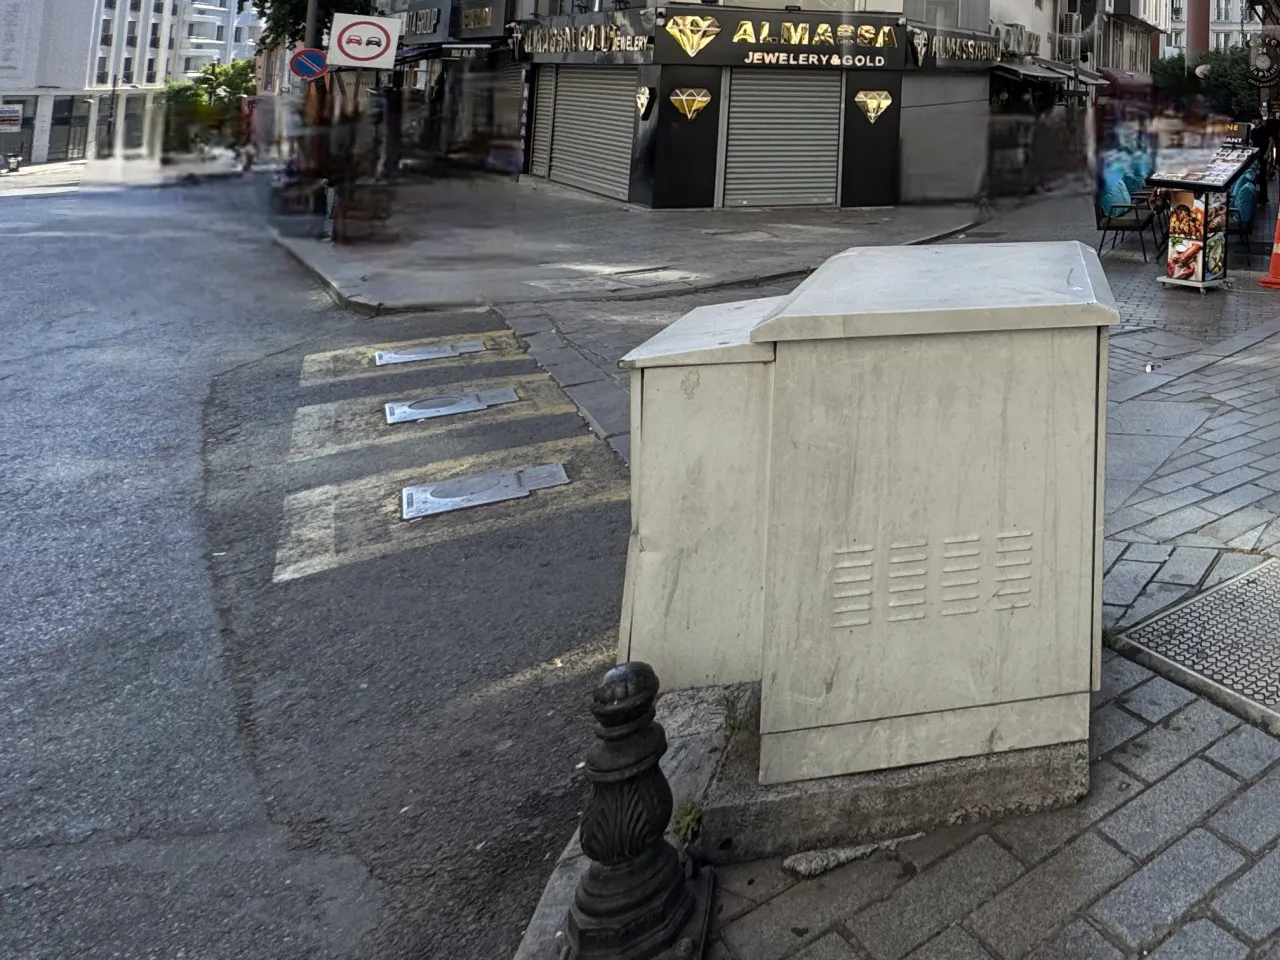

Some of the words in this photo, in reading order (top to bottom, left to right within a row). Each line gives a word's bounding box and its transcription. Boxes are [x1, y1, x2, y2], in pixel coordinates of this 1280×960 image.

[732, 20, 898, 48] ALMASSA
[612, 35, 649, 51] JEWELERY
[744, 51, 885, 67] JEWELERY&GOLD
